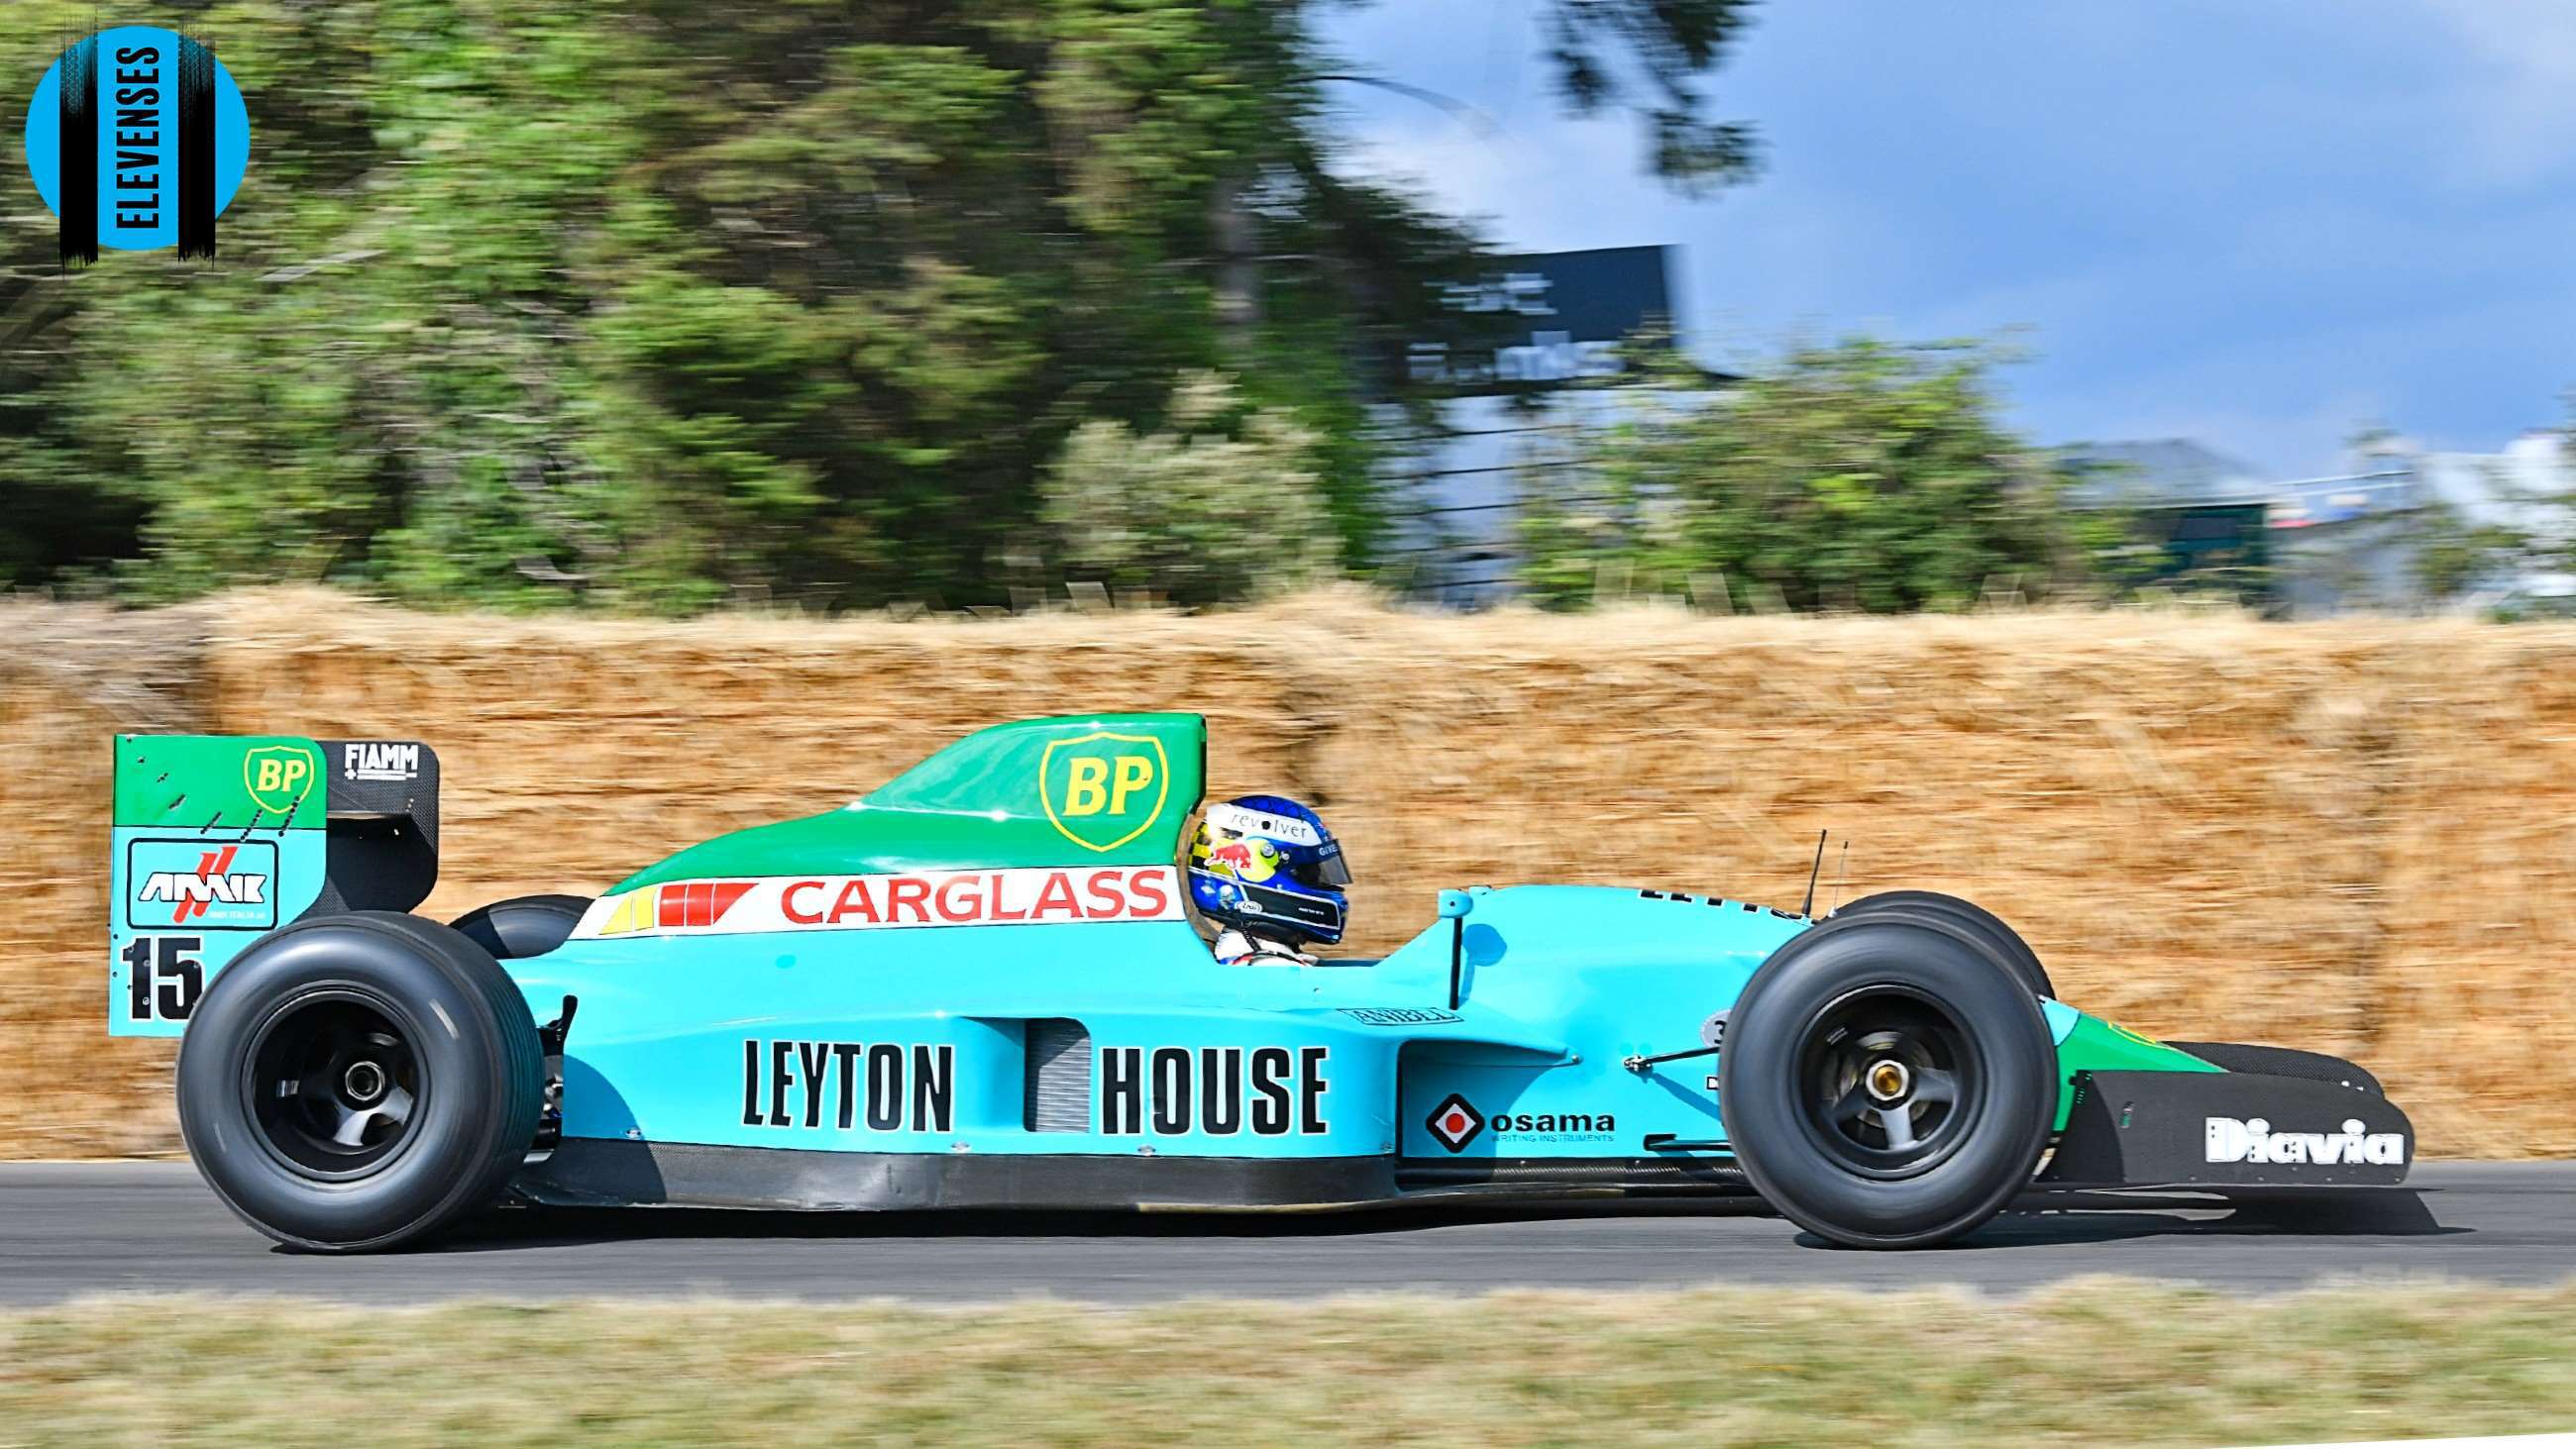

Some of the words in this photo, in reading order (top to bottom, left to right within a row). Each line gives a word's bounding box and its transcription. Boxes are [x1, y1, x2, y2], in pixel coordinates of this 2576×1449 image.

[256, 758, 307, 792] BP
[345, 743, 419, 770] FIAMM
[1063, 754, 1154, 817] BP
[780, 870, 1169, 925] CARGLASS
[123, 936, 204, 1021] 15
[742, 1039, 954, 1133] LEYTON
[1100, 1046, 1331, 1136] HOUSE
[1490, 1113, 1616, 1132] osama
[2205, 1117, 2405, 1165] Diavia
